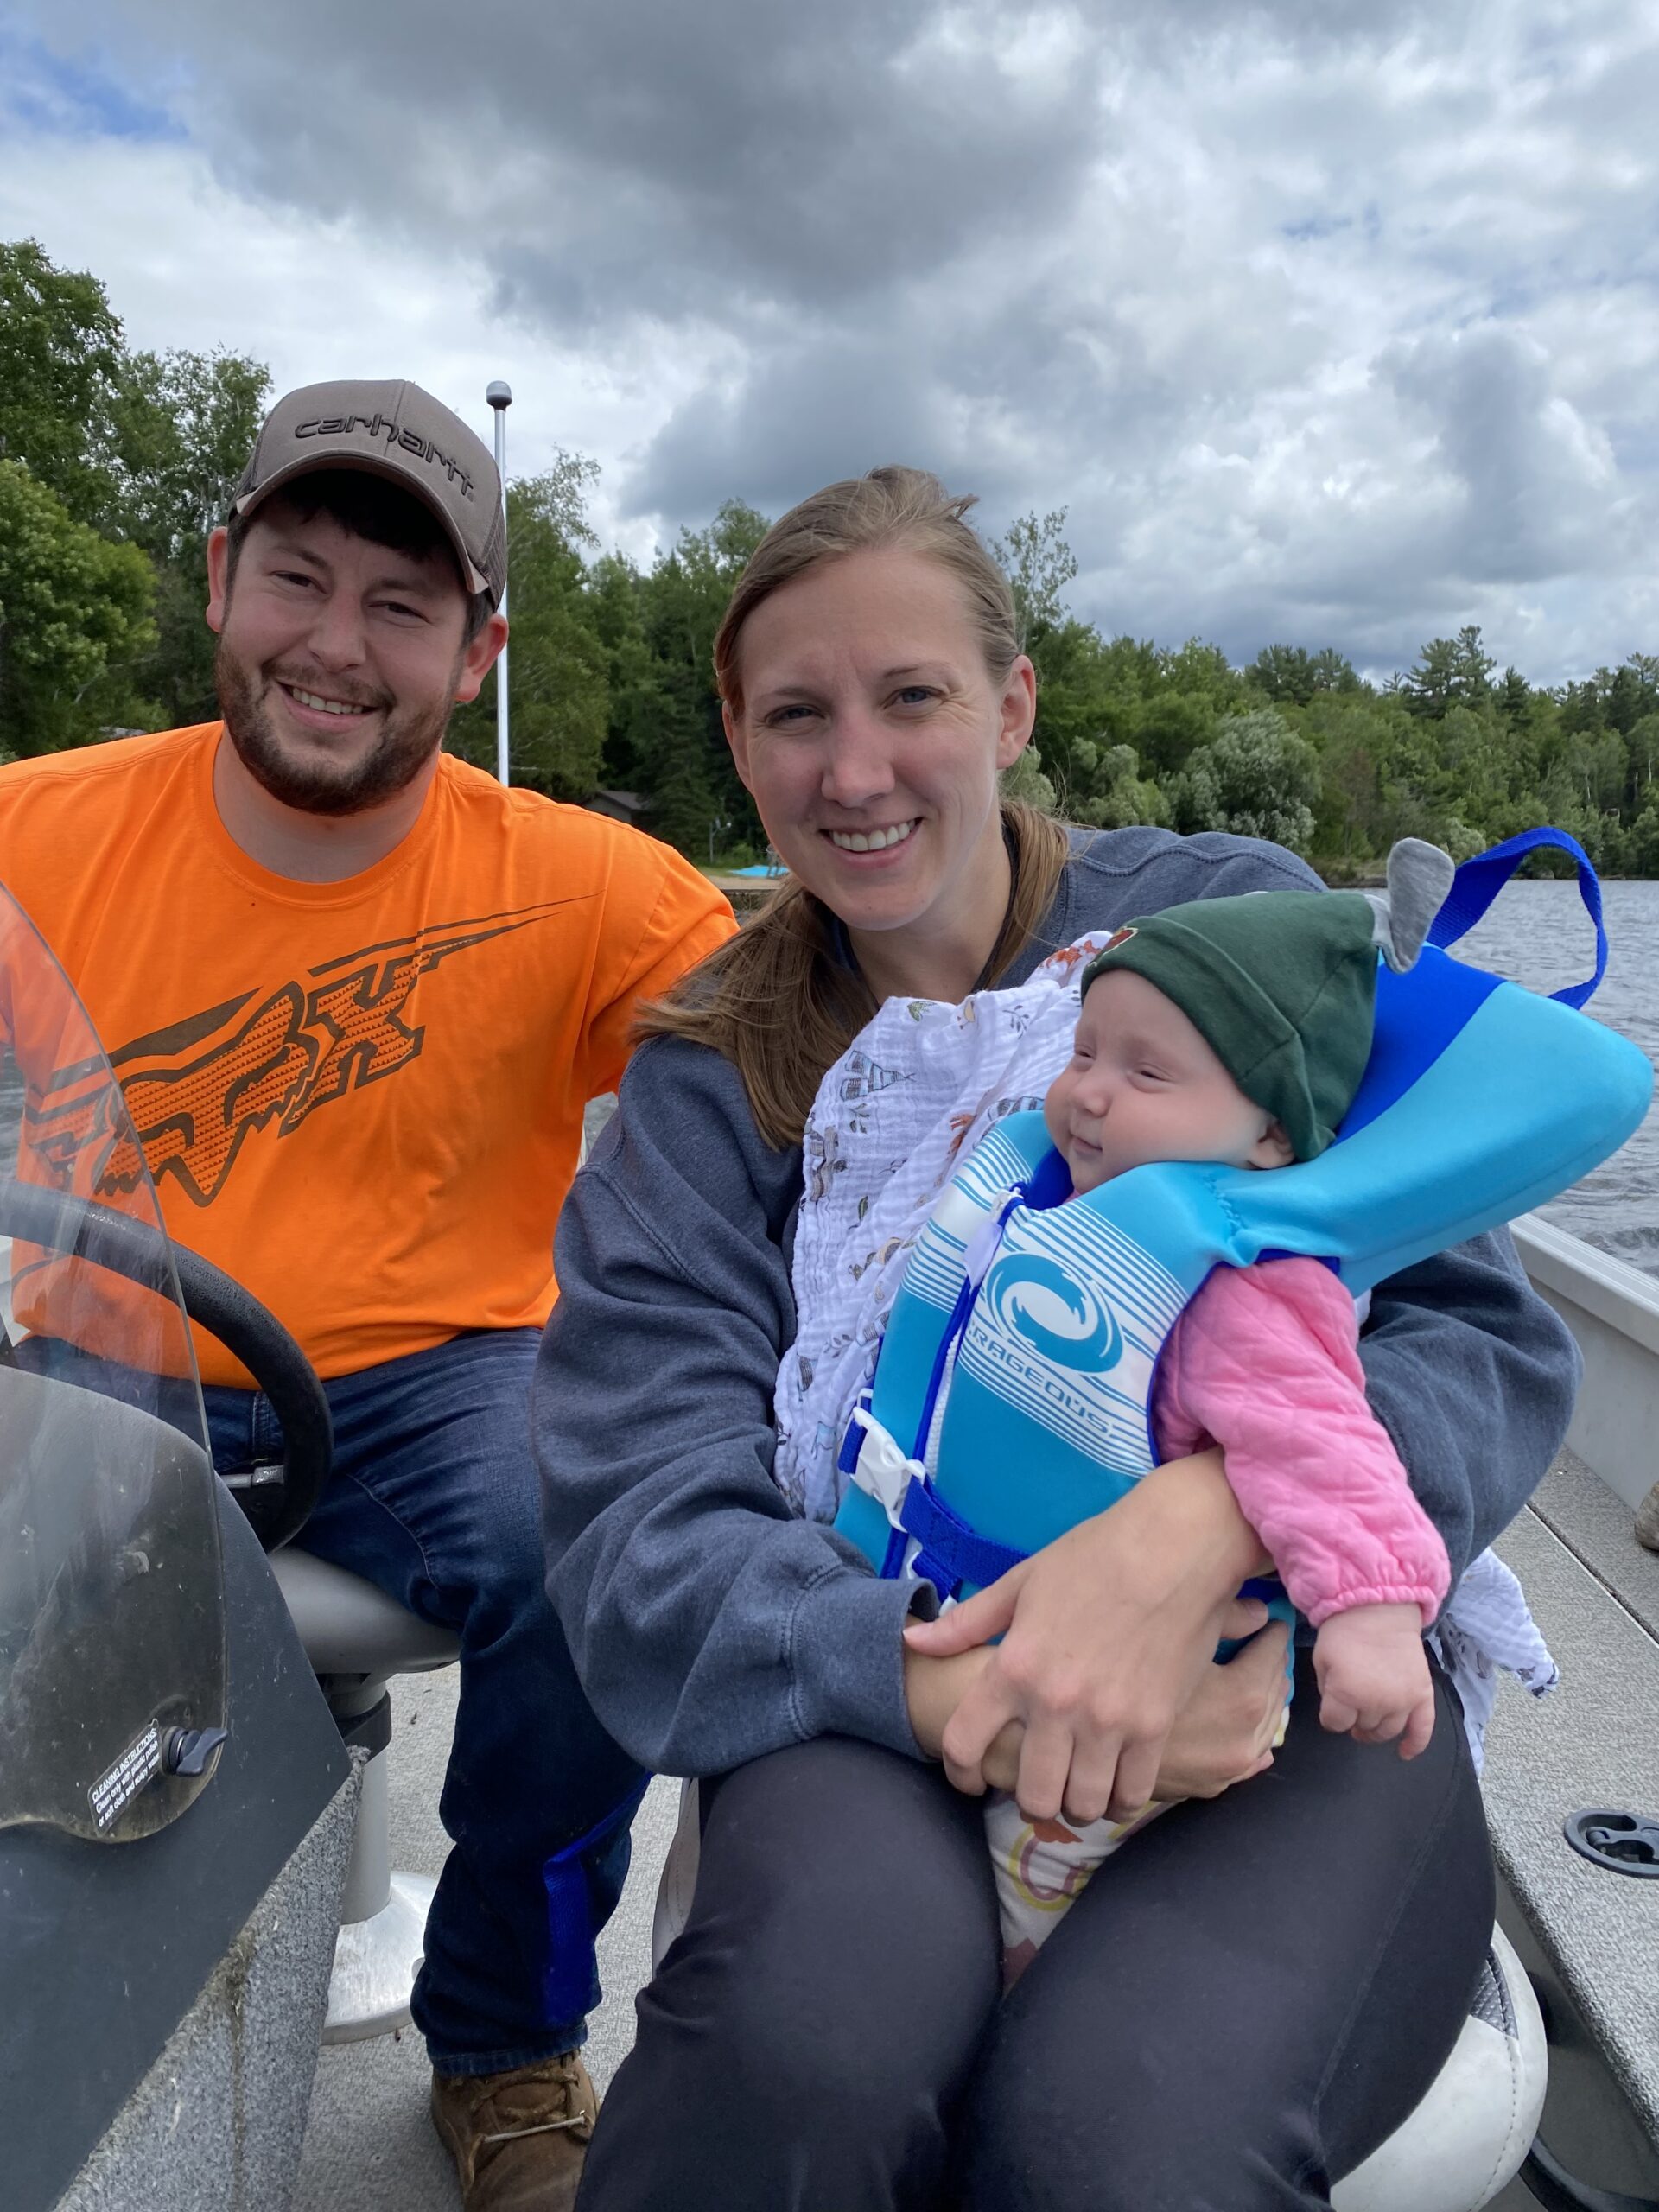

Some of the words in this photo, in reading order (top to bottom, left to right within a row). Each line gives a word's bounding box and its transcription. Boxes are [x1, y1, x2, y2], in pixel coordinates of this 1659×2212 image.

[294, 412, 474, 496] carhartt
[969, 1320, 1108, 1433] RAGEOUS
[92, 1768, 120, 1803] CLEANING
[96, 1795, 111, 1813] Clean
[111, 1782, 121, 1797] only
[121, 1771, 131, 1786] with
[131, 1755, 146, 1777] plastic
[145, 1740, 158, 1760] polish
[99, 1816, 104, 1827] or
[105, 1804, 114, 1820] soft
[114, 1792, 125, 1808] cloth
[125, 1781, 135, 1796] and
[135, 1765, 148, 1785] soapy
